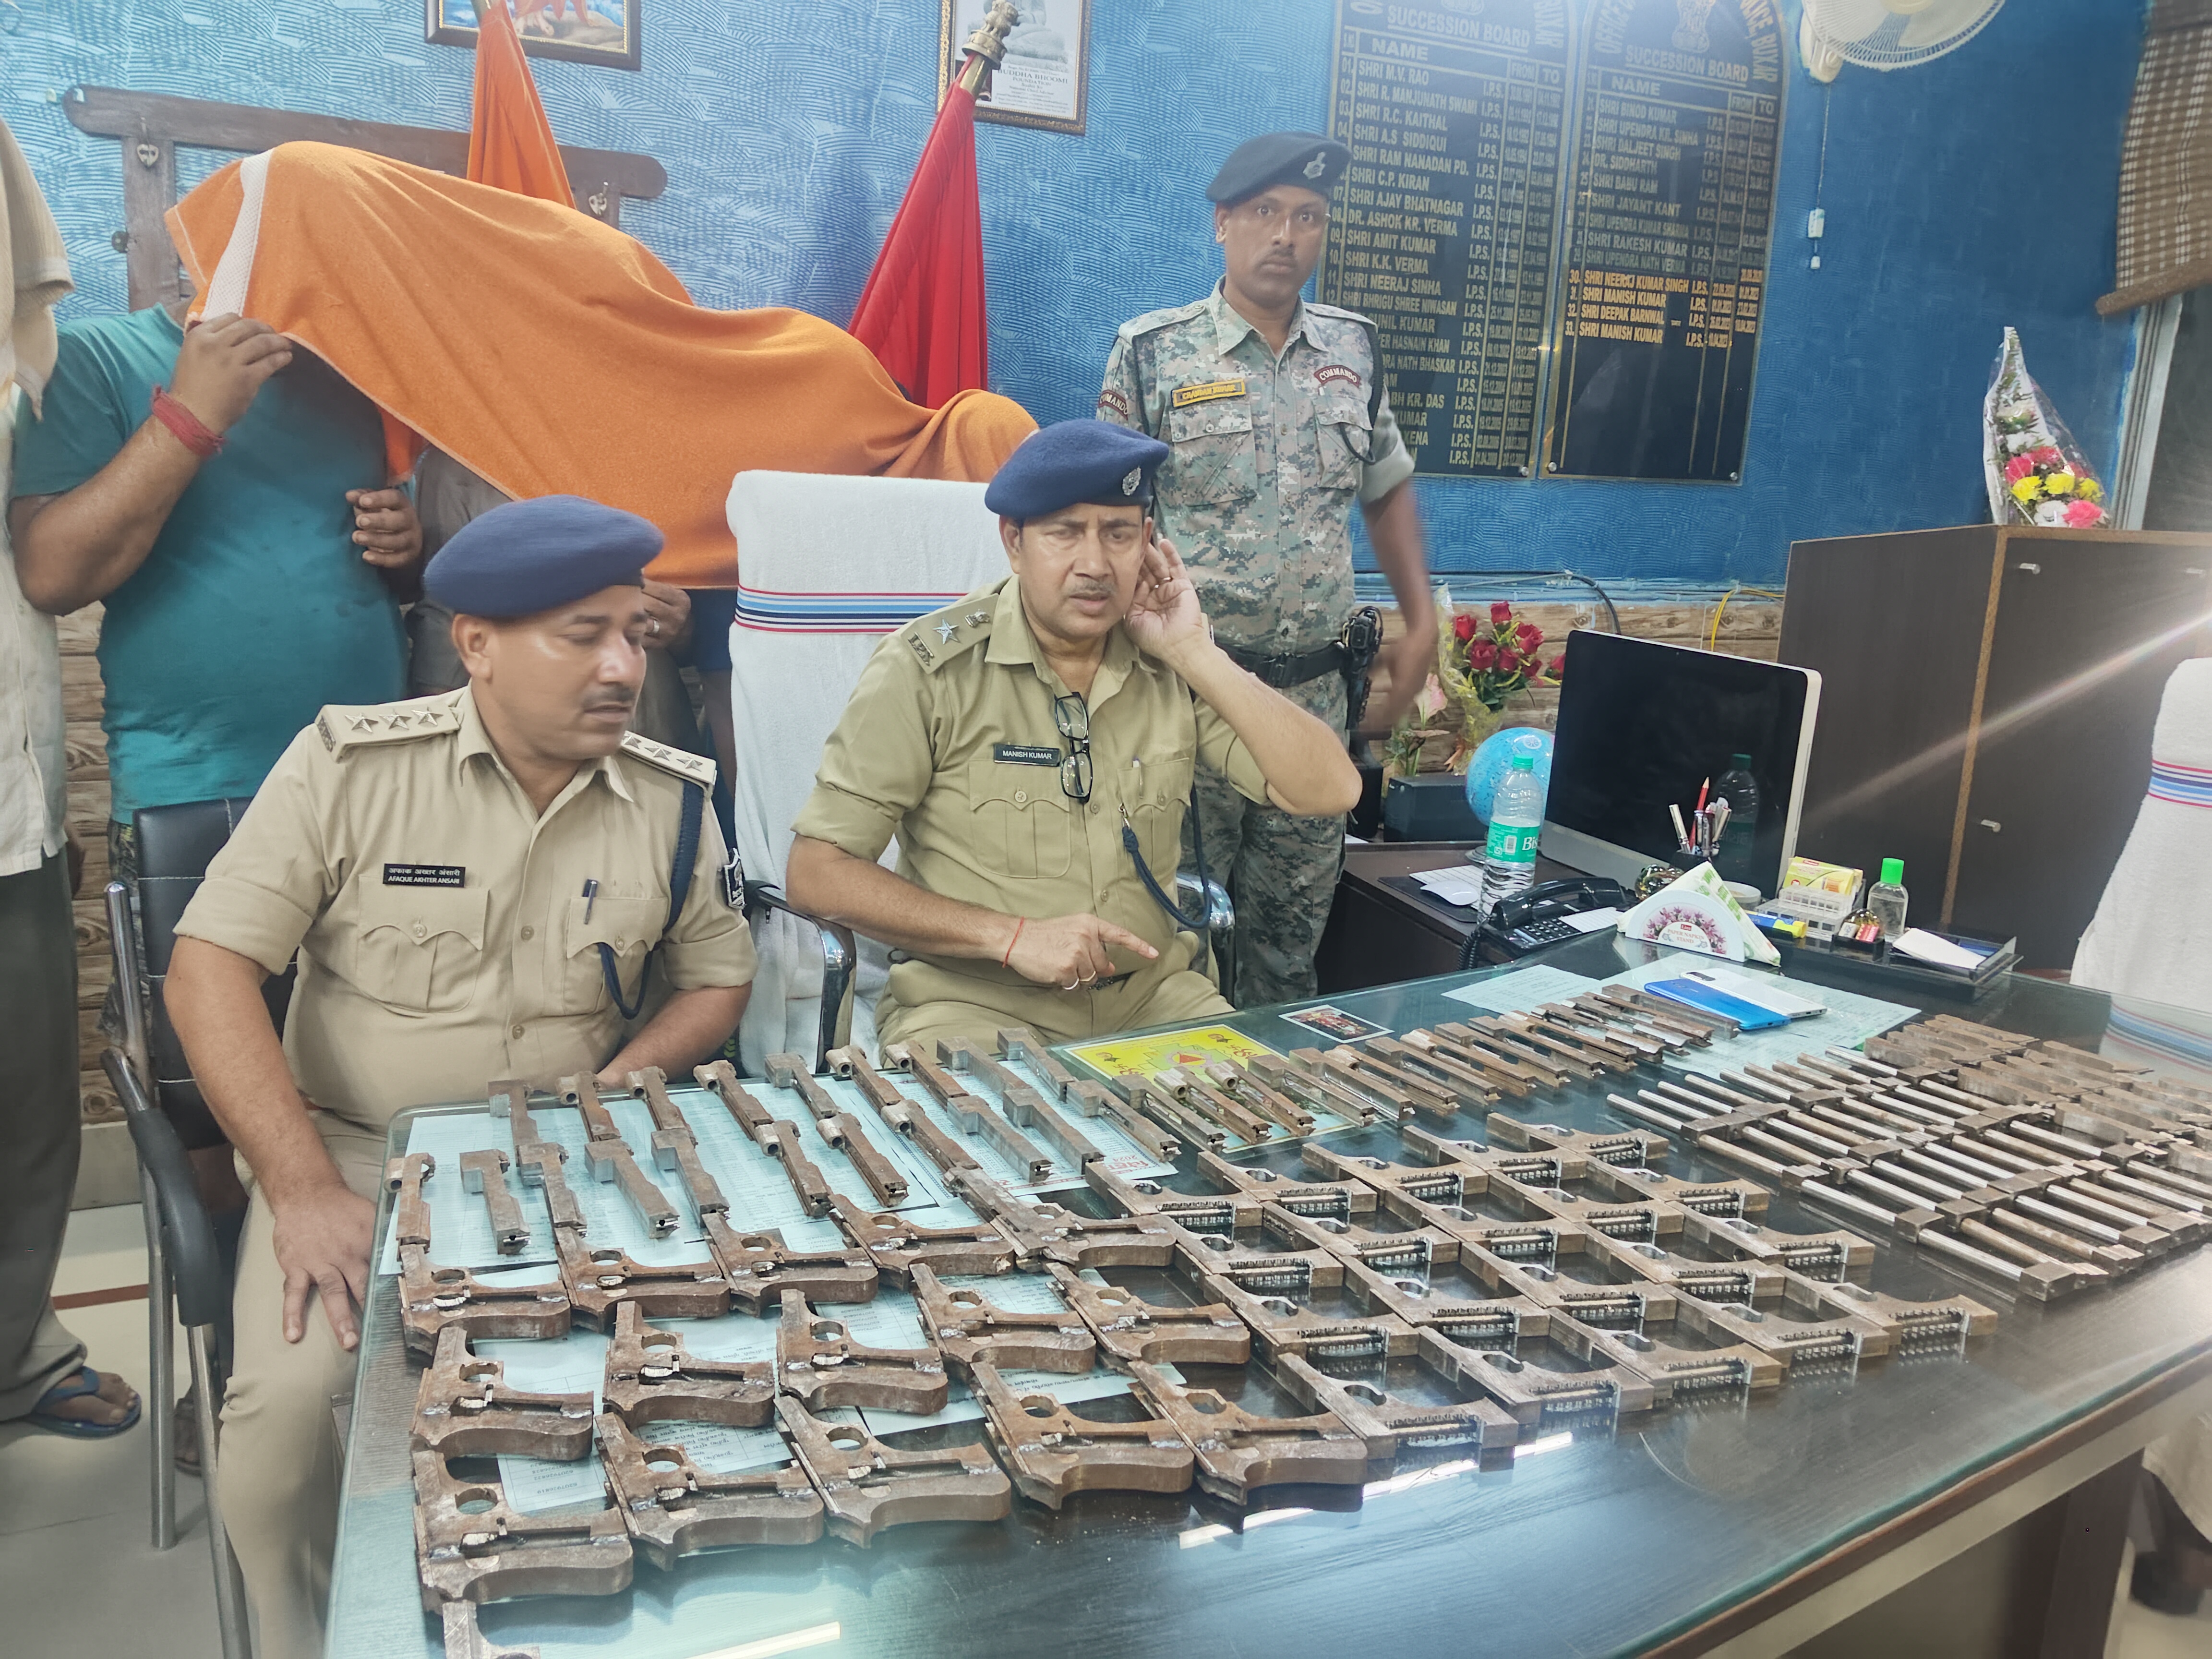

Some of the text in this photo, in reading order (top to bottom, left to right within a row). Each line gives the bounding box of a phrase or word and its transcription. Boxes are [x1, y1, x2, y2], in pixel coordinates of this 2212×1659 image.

[1388, 5, 1480, 40] SUCCESSION
[1483, 23, 1530, 47] BOARD
[1371, 38, 1428, 61] NAME
[1511, 62, 1535, 79] FROM
[1542, 67, 1560, 84] TO
[1625, 44, 1749, 83] SUCCESSION BOARD
[1751, 34, 1779, 83] BUXAR
[998, 69, 1033, 78] BUDDHA
[1035, 74, 1068, 84] BHOOMI
[1013, 77, 1051, 86] FOUNDATION
[1358, 59, 1383, 79] SHRI
[1385, 64, 1406, 82] M.V.
[1408, 68, 1429, 86] RAO
[1482, 80, 1504, 98] I.P.S.
[1357, 81, 1502, 119] SHRI R. MANJUNATH SWAMI I.P.S.
[1611, 75, 1661, 96] NAME
[1758, 100, 1774, 116] TO
[1355, 102, 1501, 139] SHRI R.C. KAITHAL I.P.S.
[1354, 123, 1379, 142] SHRI
[1402, 131, 1447, 152] SIDDIQUI
[1477, 142, 1499, 159] I.P.S.
[1352, 145, 1497, 180] SHRI RAM NANADAN PD. I.P.S.
[1351, 167, 1495, 200] SHRI C.P. KIRAN I.P.S.
[1349, 188, 1374, 205] SHRI
[1376, 191, 1402, 209] AJAY
[1404, 194, 1464, 216] BHATNAGAR
[1473, 204, 1494, 220] I.P.S.
[1591, 192, 1681, 218] SHRI JAYANT KANT
[1348, 208, 1365, 225] DR.
[1367, 211, 1403, 229] ASHOK
[1405, 216, 1421, 232] KR.
[1423, 218, 1458, 236] VERMA
[1471, 224, 1492, 240] I.P.S.
[1346, 229, 1370, 247] SHRI
[1372, 232, 1398, 250] AMIT
[1400, 236, 1436, 254] KUMAR
[1469, 243, 1491, 260] I.P.S.
[1587, 230, 1611, 248] SHRI
[1613, 234, 1652, 253] RAKESH
[1653, 239, 1688, 258] KUMAR
[1345, 251, 1369, 268] SHRI
[1371, 253, 1392, 270] K.K.
[1394, 256, 1429, 274] VERMA
[1467, 264, 1489, 280] I.P.S.
[1344, 271, 1487, 300] SHRI NEERAJ SINHA I.P.S.
[1584, 269, 1689, 294] SHRI NEERAJ KUMAR SINGH
[1342, 291, 1485, 319] SHRI BHRIGU SHREE NIWASAN I.P.S.
[1582, 285, 1602, 302] SHRI
[1603, 287, 1636, 306] MANISH
[1636, 290, 1667, 309] KUMAR
[1399, 315, 1484, 337] KUMAR I.P.S.
[1581, 303, 1599, 319] SHRI
[1600, 304, 1629, 323] DEEPAK
[1630, 307, 1665, 326] BARNWAL
[1392, 334, 1482, 356] HASNAIN KHAN I.P.S.
[1578, 320, 1599, 338] SHRI
[1600, 322, 1633, 341] MANISH
[1633, 325, 1663, 345] KUMAR
[1319, 369, 1358, 383] COMMANDO
[1397, 355, 1479, 375] NATH BHASKAR I.P.S.
[1456, 378, 1478, 393] I.P.S.
[1407, 392, 1476, 411] KR. DAS I.P.S.
[1453, 414, 1474, 429] I.P.S.
[1451, 433, 1472, 448] I.P.S.
[1449, 450, 1470, 465] I.P.S.
